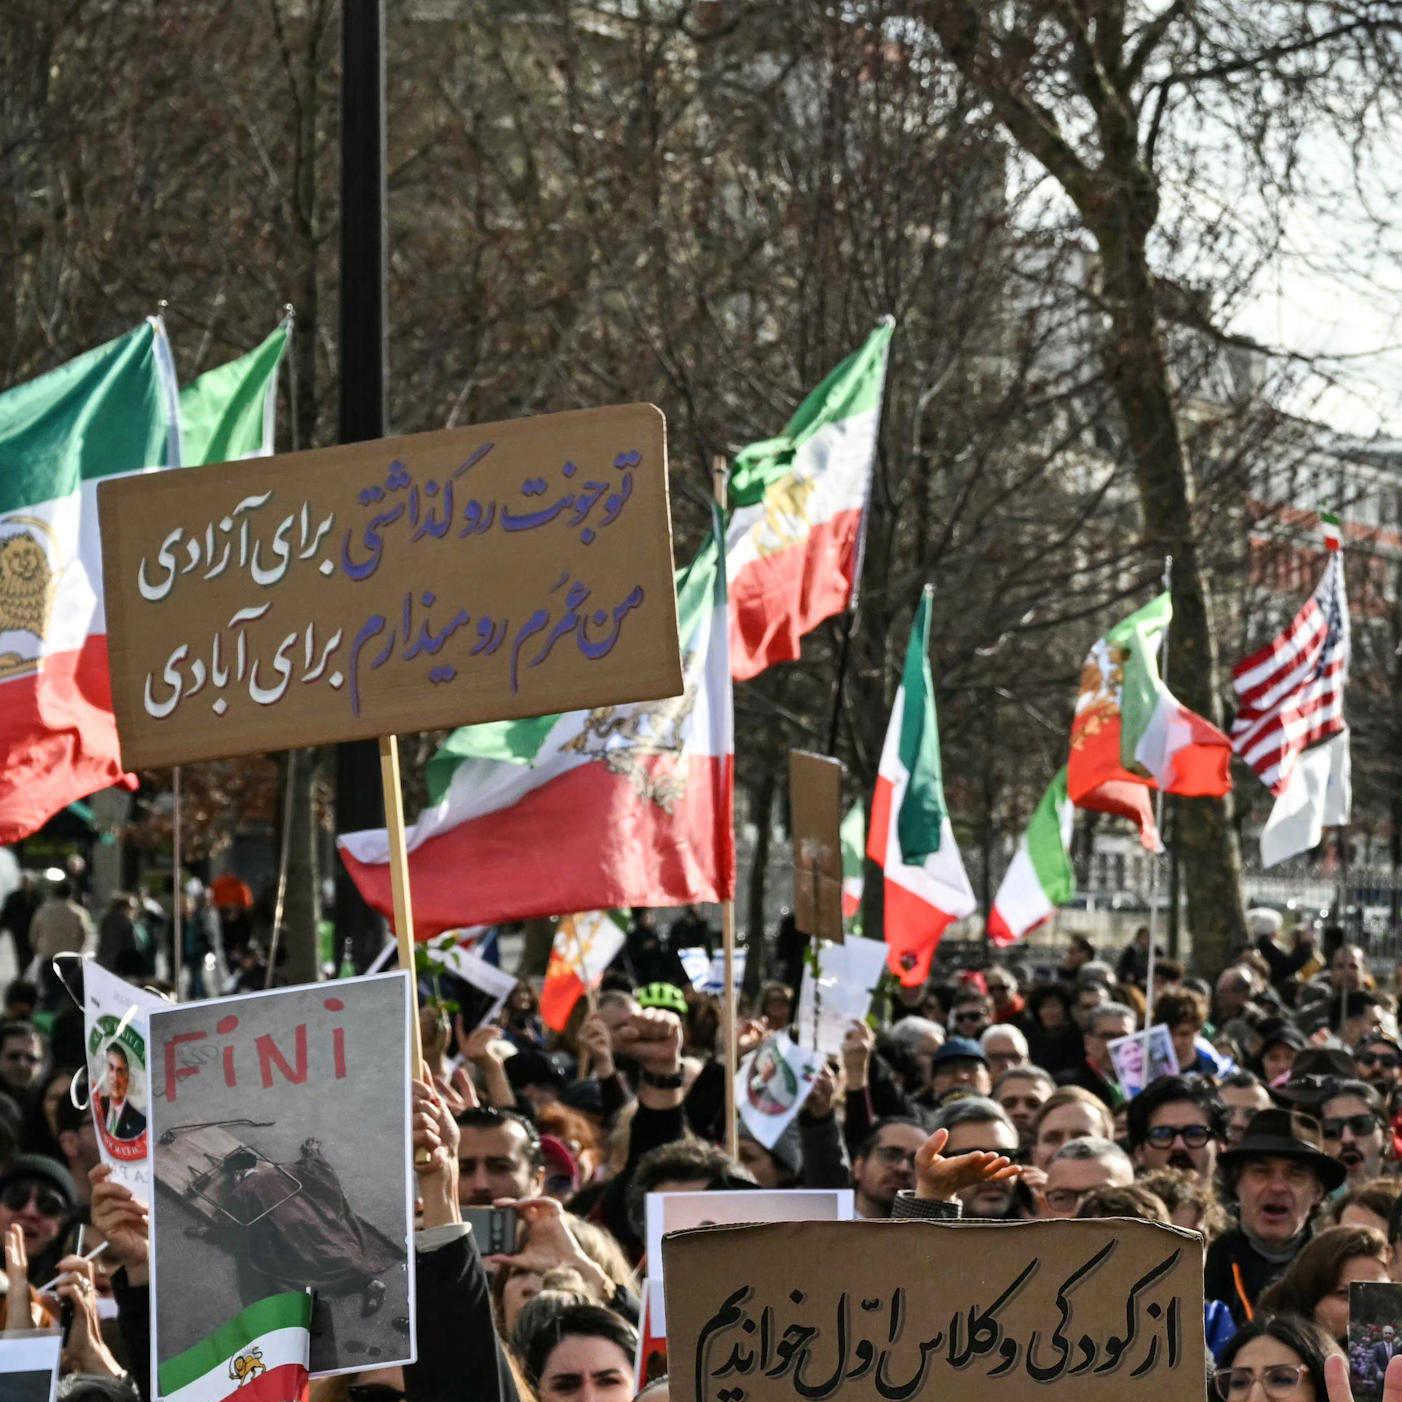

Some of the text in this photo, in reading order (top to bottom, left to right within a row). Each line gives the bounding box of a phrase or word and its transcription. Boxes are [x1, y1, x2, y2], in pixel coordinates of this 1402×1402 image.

[458, 499, 497, 539] رو
[598, 449, 643, 528] تو
[136, 489, 275, 602] آزادی
[251, 499, 335, 586] برای
[142, 600, 274, 720] آبادی
[248, 620, 345, 706] برای
[469, 613, 509, 658] رو
[576, 584, 645, 660] من
[874, 1256, 1042, 1402] کلاس
[1027, 1238, 1183, 1384] کودکی
[1130, 1295, 1182, 1379] از
[986, 1334, 1020, 1378] و
